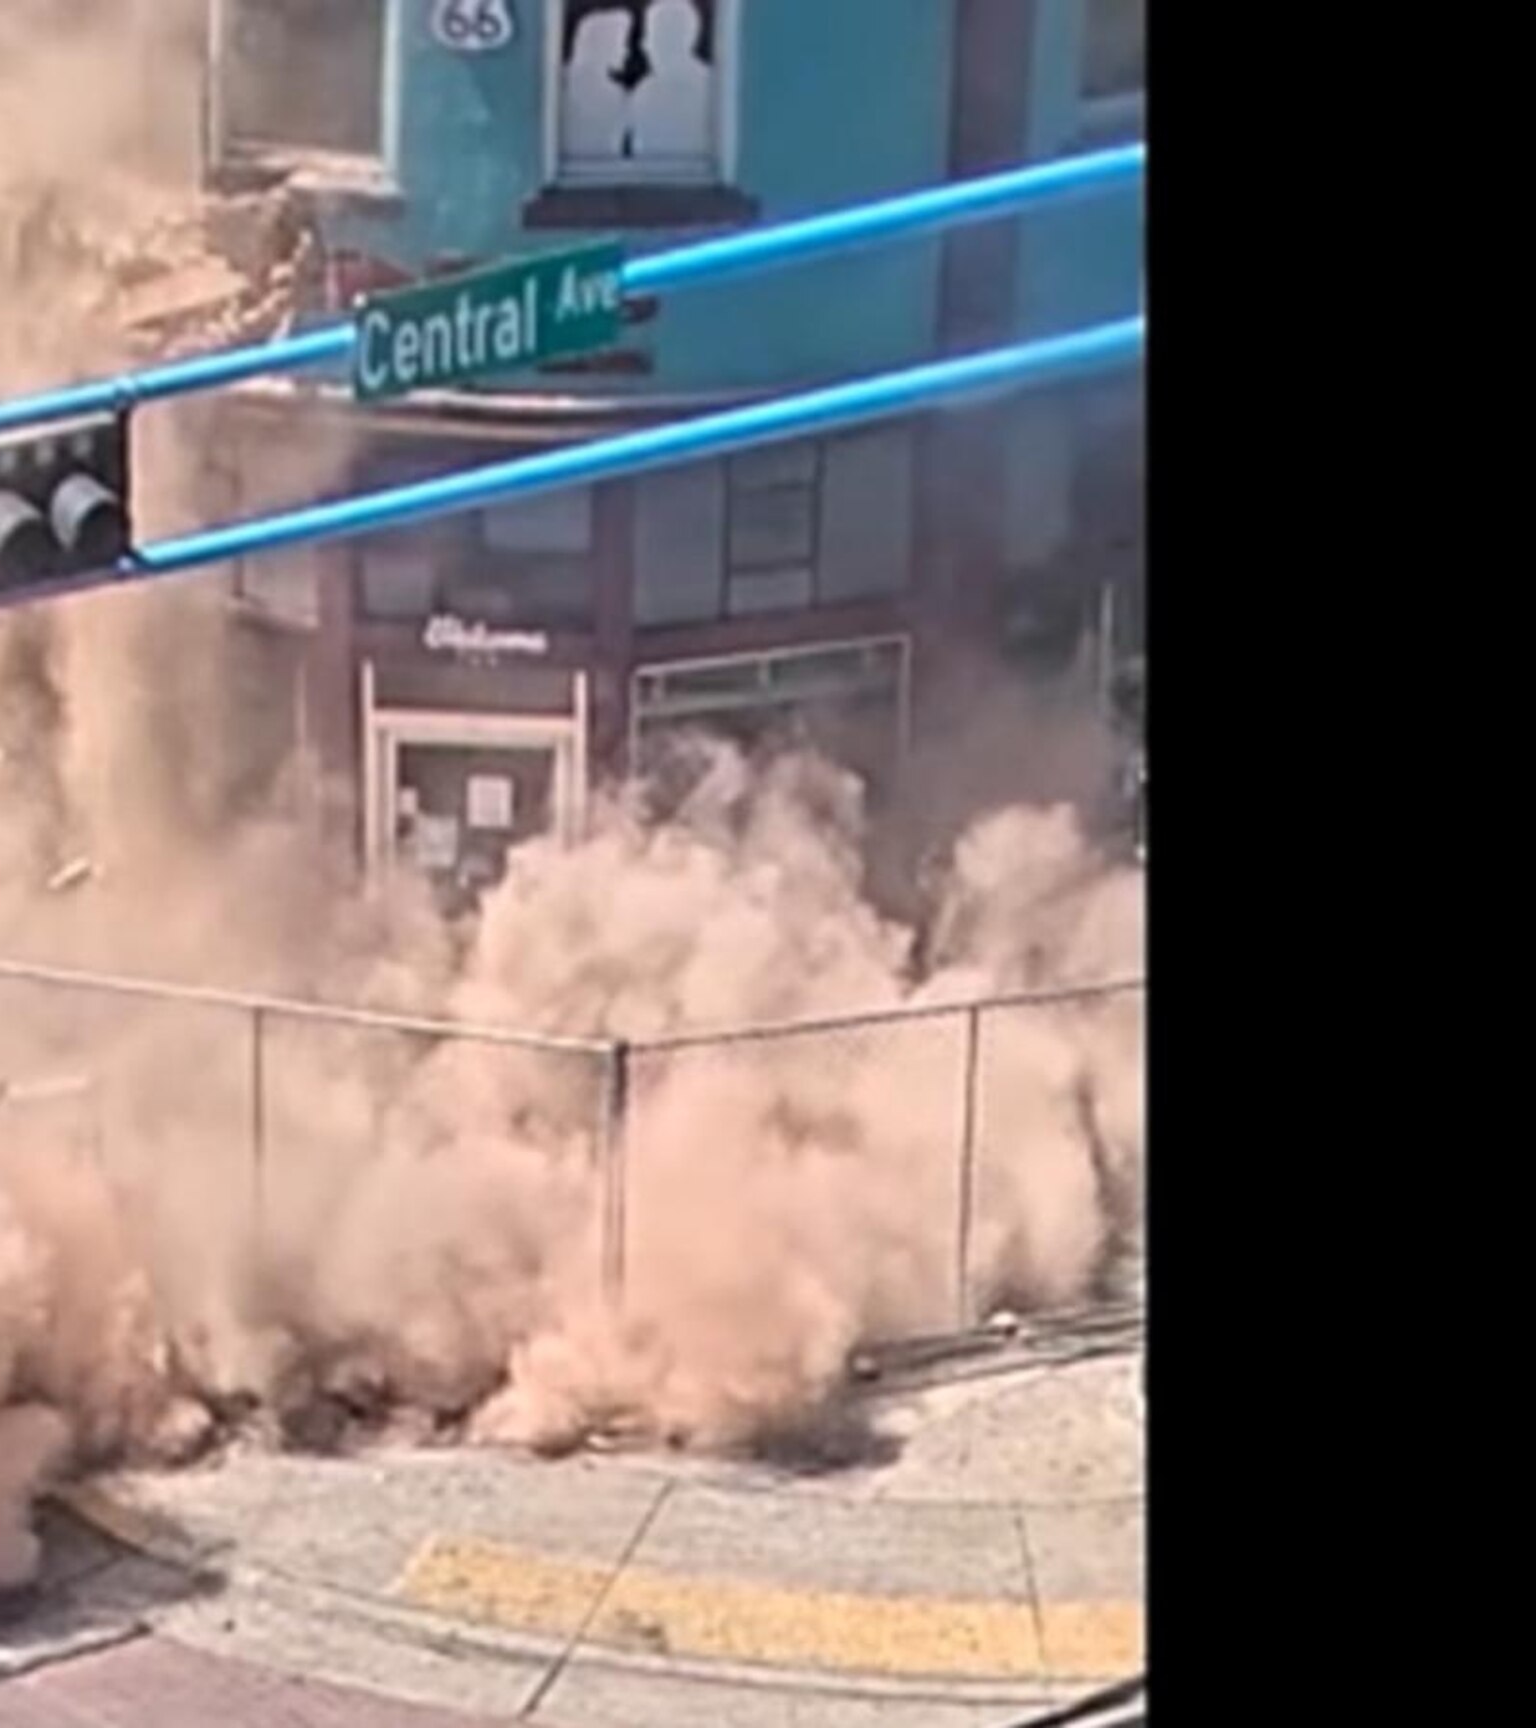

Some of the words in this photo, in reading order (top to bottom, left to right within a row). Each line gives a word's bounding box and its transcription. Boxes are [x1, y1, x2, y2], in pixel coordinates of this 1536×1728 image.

[442, 0, 502, 39] 66
[360, 276, 538, 389] Central
[555, 266, 620, 323] Ave
